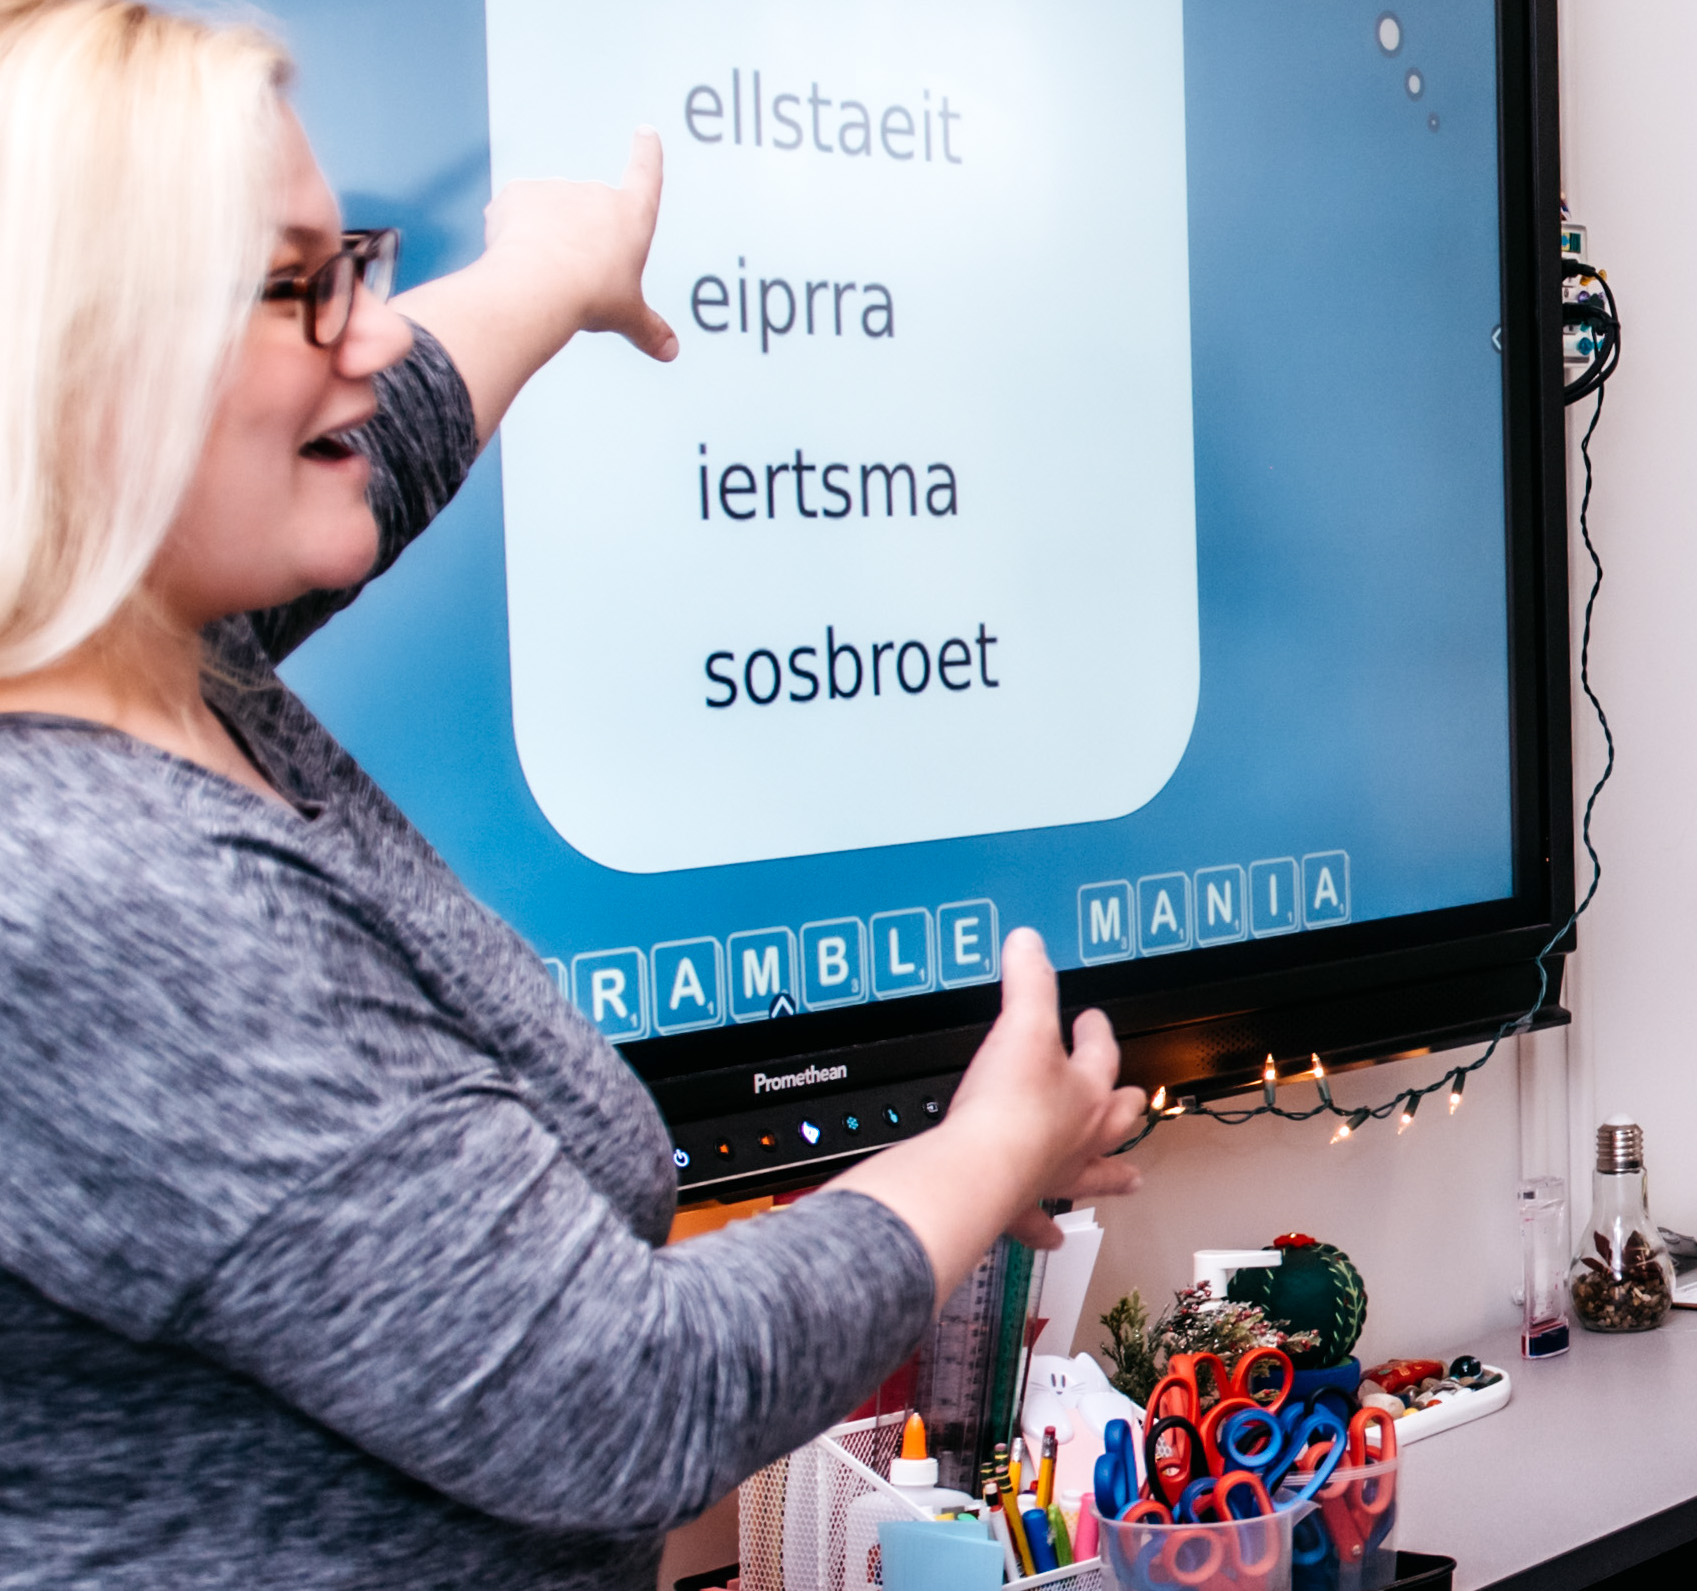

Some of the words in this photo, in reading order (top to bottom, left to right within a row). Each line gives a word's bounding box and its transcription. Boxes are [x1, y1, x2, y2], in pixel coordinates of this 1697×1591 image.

[684, 67, 963, 165] ellstaeit
[690, 256, 896, 354] eiprra
[697, 442, 959, 522] iertsma
[704, 621, 1000, 709] sosbroet
[592, 917, 981, 1022] RAMBLE
[1090, 867, 1338, 944] MANIA
[753, 1064, 848, 1094] Promethean
